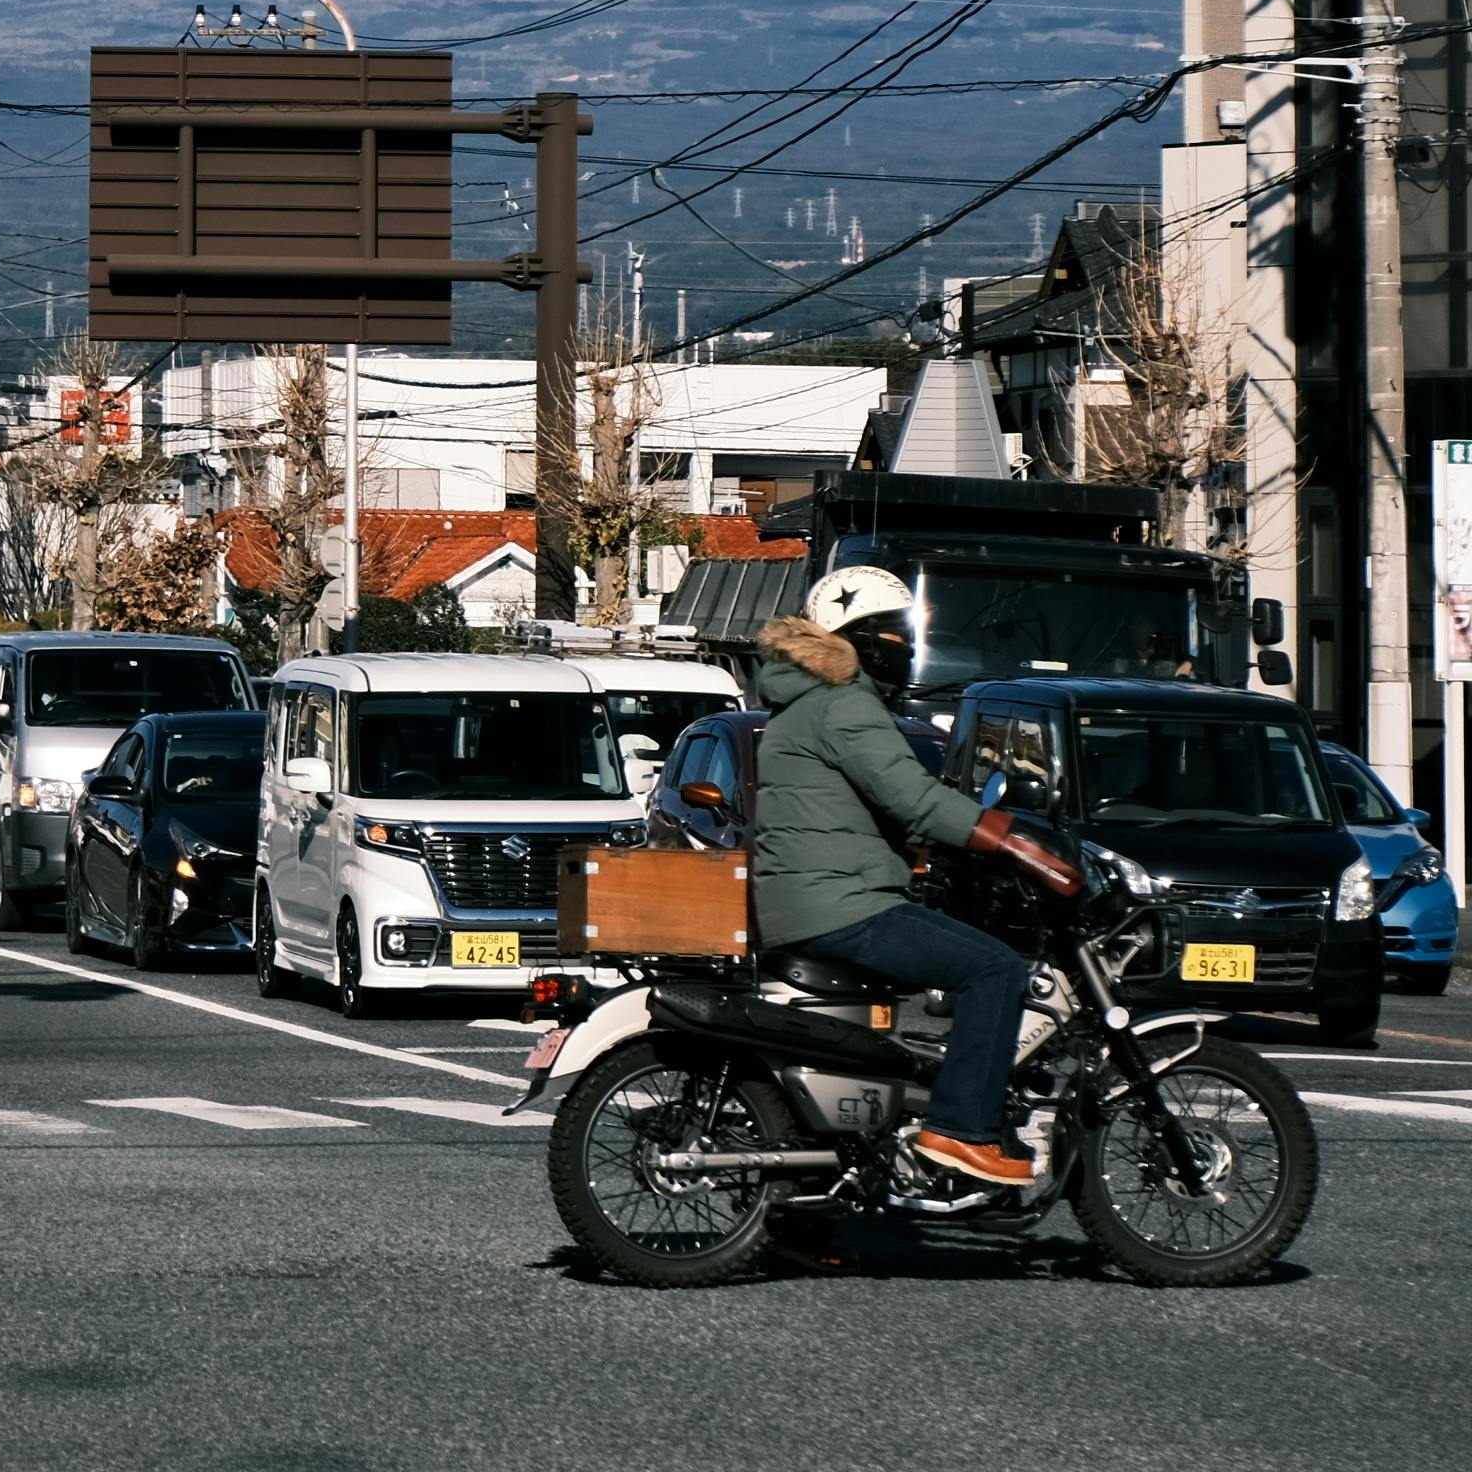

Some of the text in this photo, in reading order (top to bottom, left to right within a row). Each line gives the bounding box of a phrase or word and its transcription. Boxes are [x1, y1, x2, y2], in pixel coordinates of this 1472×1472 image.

[467, 946, 516, 964] 42-45
[1199, 959, 1247, 979] 96-31
[1015, 1019, 1055, 1051] NDA
[838, 1097, 862, 1113] CT
